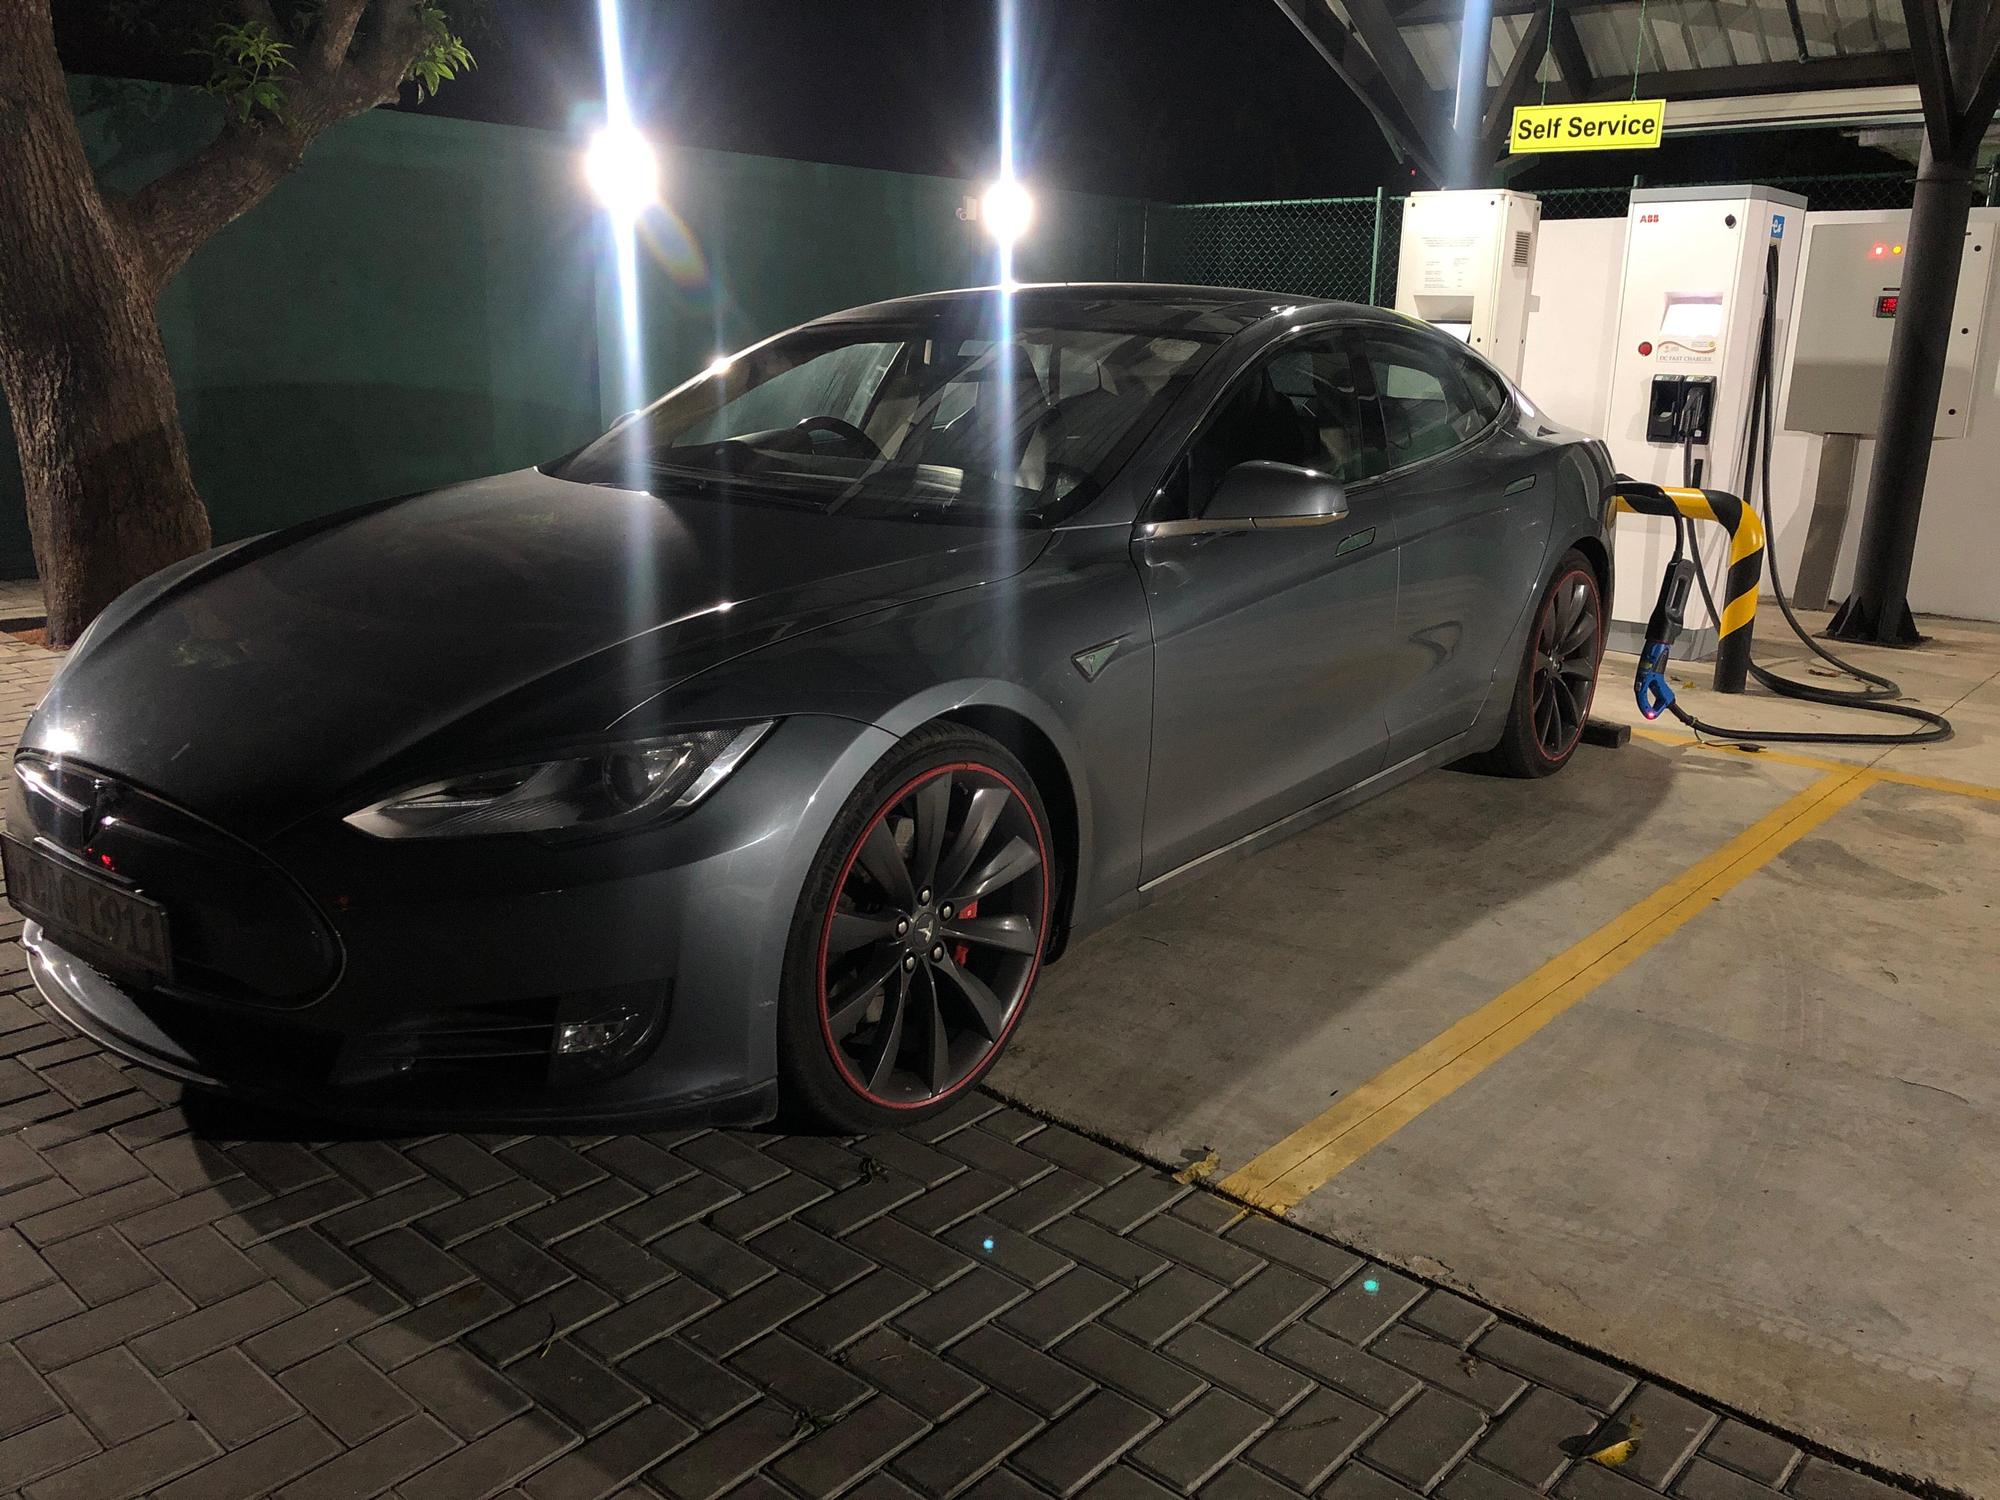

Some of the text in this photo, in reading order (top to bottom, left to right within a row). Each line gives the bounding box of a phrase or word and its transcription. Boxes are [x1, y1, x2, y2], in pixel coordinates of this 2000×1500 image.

[1518, 114, 1656, 140] Self Service
[1639, 214, 1659, 223] ABB
